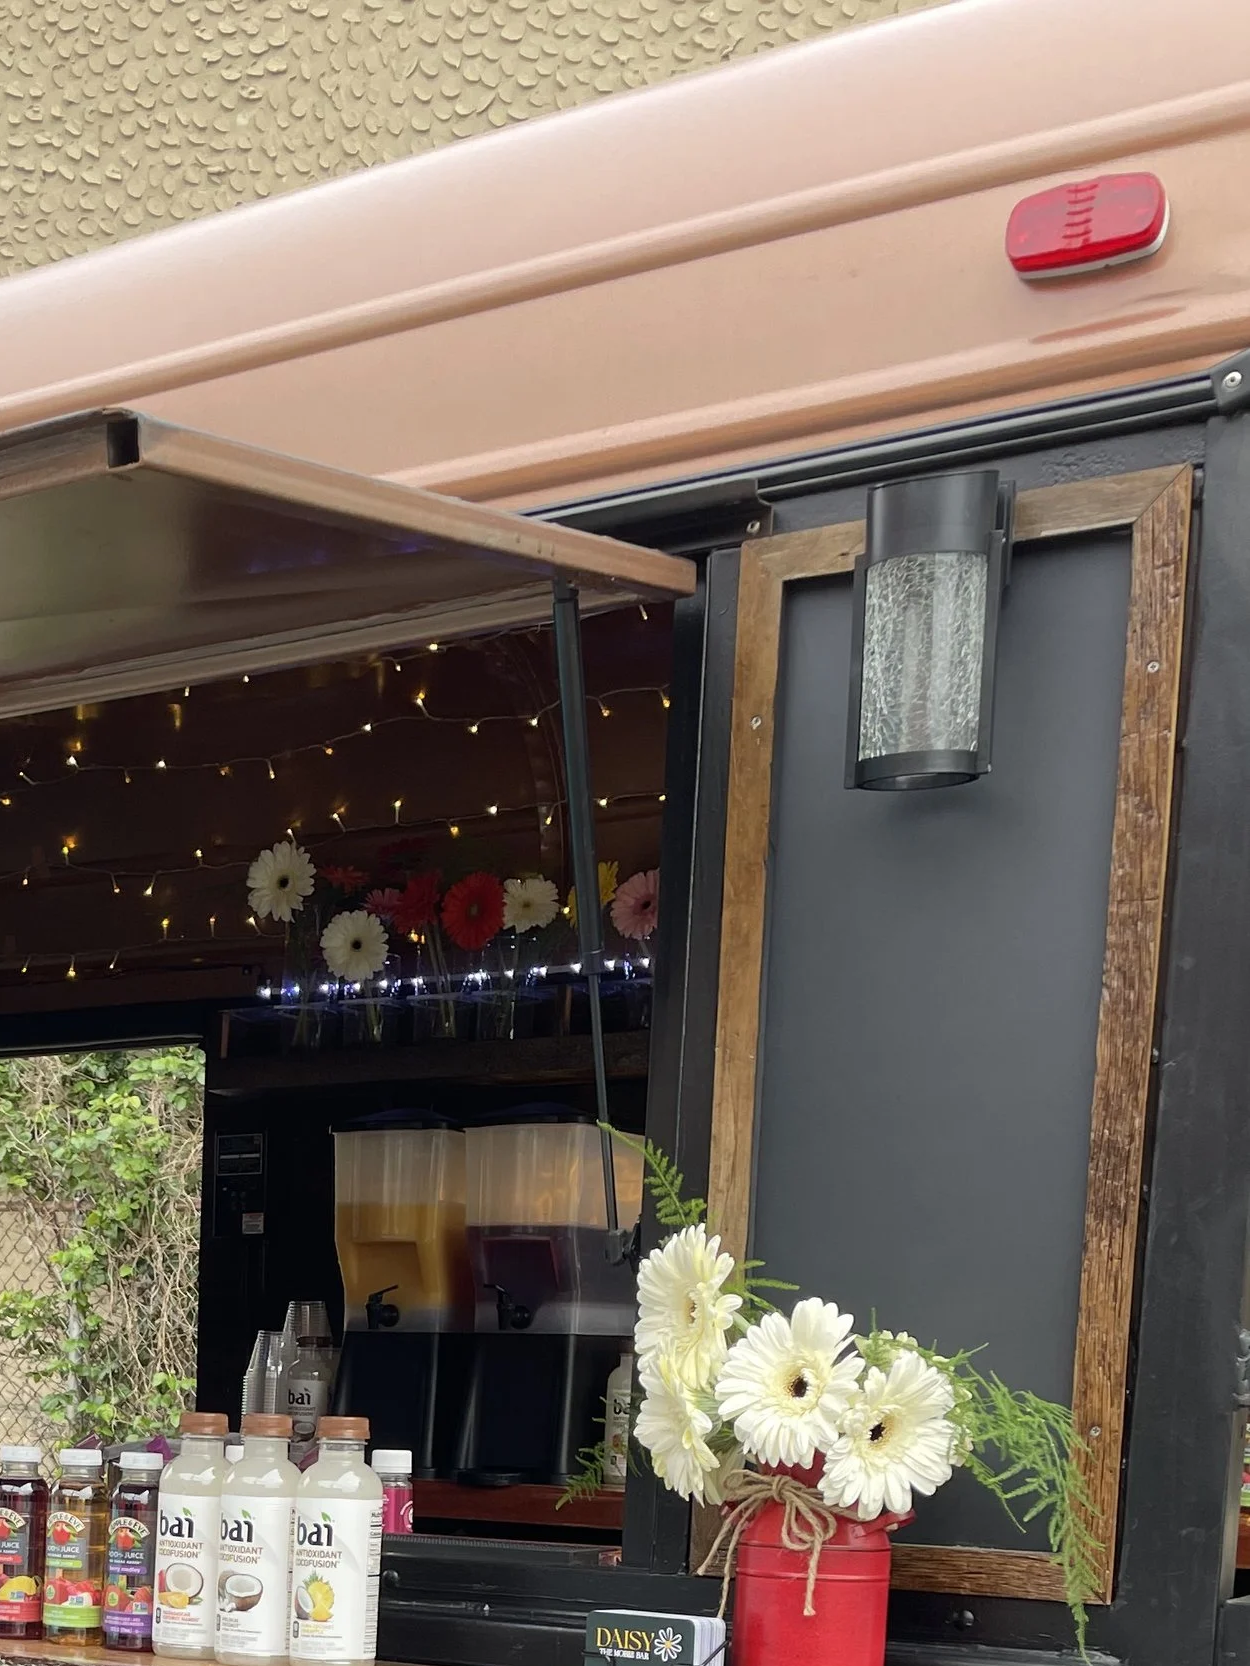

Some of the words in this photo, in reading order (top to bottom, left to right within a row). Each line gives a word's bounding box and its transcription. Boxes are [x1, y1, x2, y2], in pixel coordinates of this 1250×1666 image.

[160, 1507, 195, 1539] bai
[221, 1509, 253, 1543] bai
[297, 1511, 333, 1547] bai
[1, 1541, 20, 1549] JUICE
[60, 1545, 80, 1554] JUICE
[124, 1551, 145, 1560] JUICE
[596, 1627, 655, 1652] DAISY
[599, 1647, 613, 1656] THE
[636, 1651, 650, 1660] BAR
